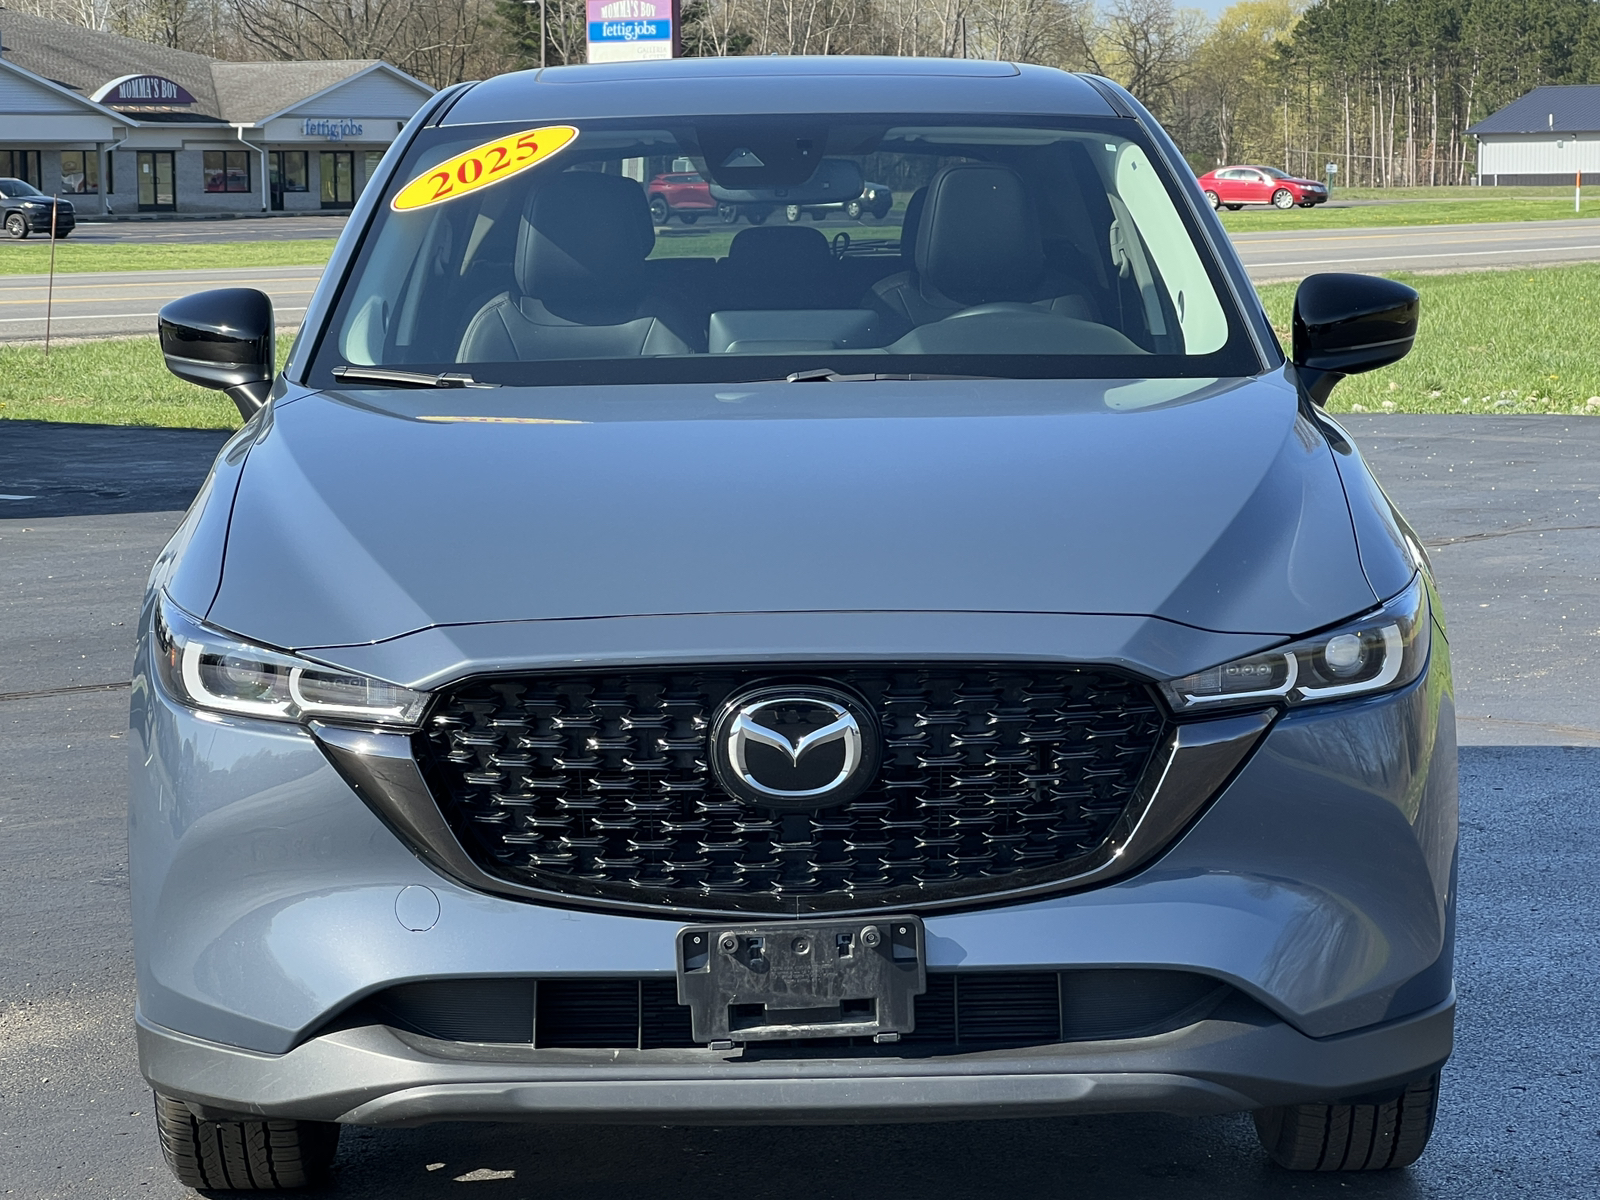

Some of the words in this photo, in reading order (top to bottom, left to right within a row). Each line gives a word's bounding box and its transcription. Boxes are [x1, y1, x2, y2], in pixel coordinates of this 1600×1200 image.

[601, 0, 639, 18] MOMMA'S
[640, 1, 656, 17] BOY
[602, 20, 656, 40] fettig.jobs
[119, 78, 159, 99] MOMMA'S
[161, 80, 178, 99] BOY
[427, 133, 539, 201] 2025
